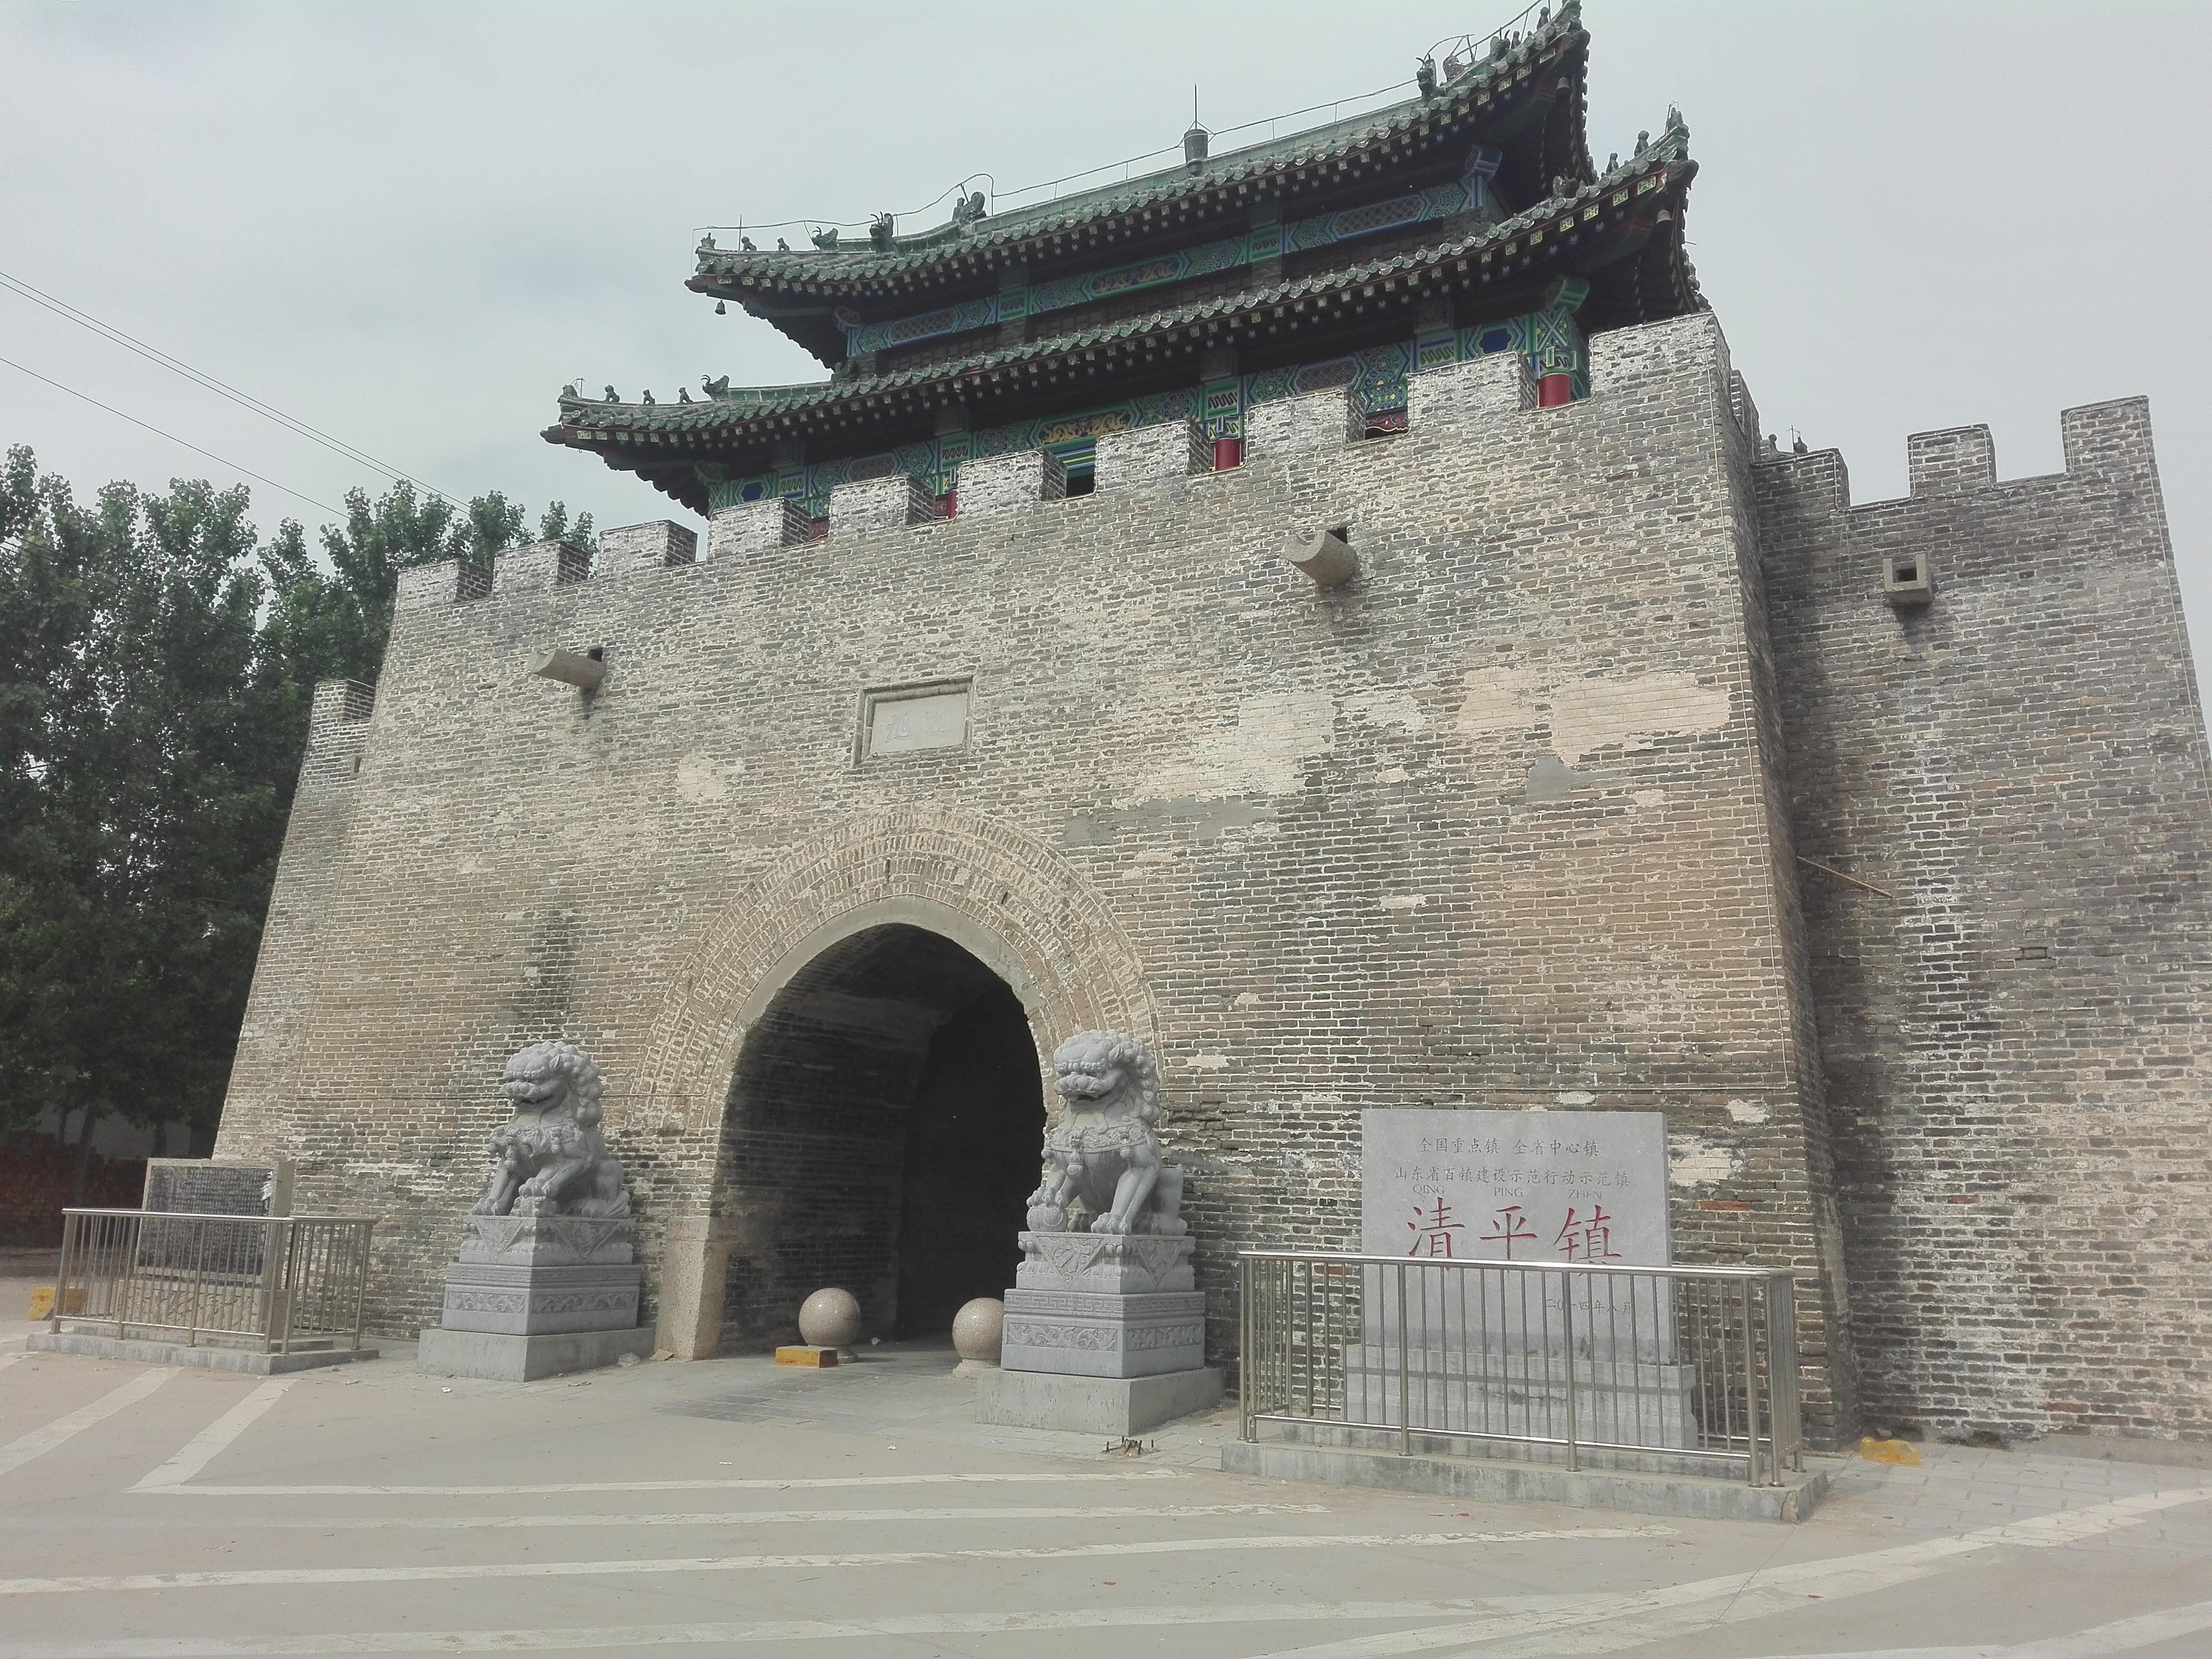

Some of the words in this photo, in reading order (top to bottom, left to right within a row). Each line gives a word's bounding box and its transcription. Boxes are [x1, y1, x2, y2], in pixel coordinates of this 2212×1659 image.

[1419, 1137, 1500, 1154] 全国重点镇
[1513, 1139, 1599, 1157] 全省中心镇
[1395, 1166, 1630, 1187] 山东省百镇建设示范行动示范镇
[1413, 1184, 1445, 1195] QING
[1494, 1187, 1523, 1198] PING
[1407, 1196, 1622, 1277] 清平镇
